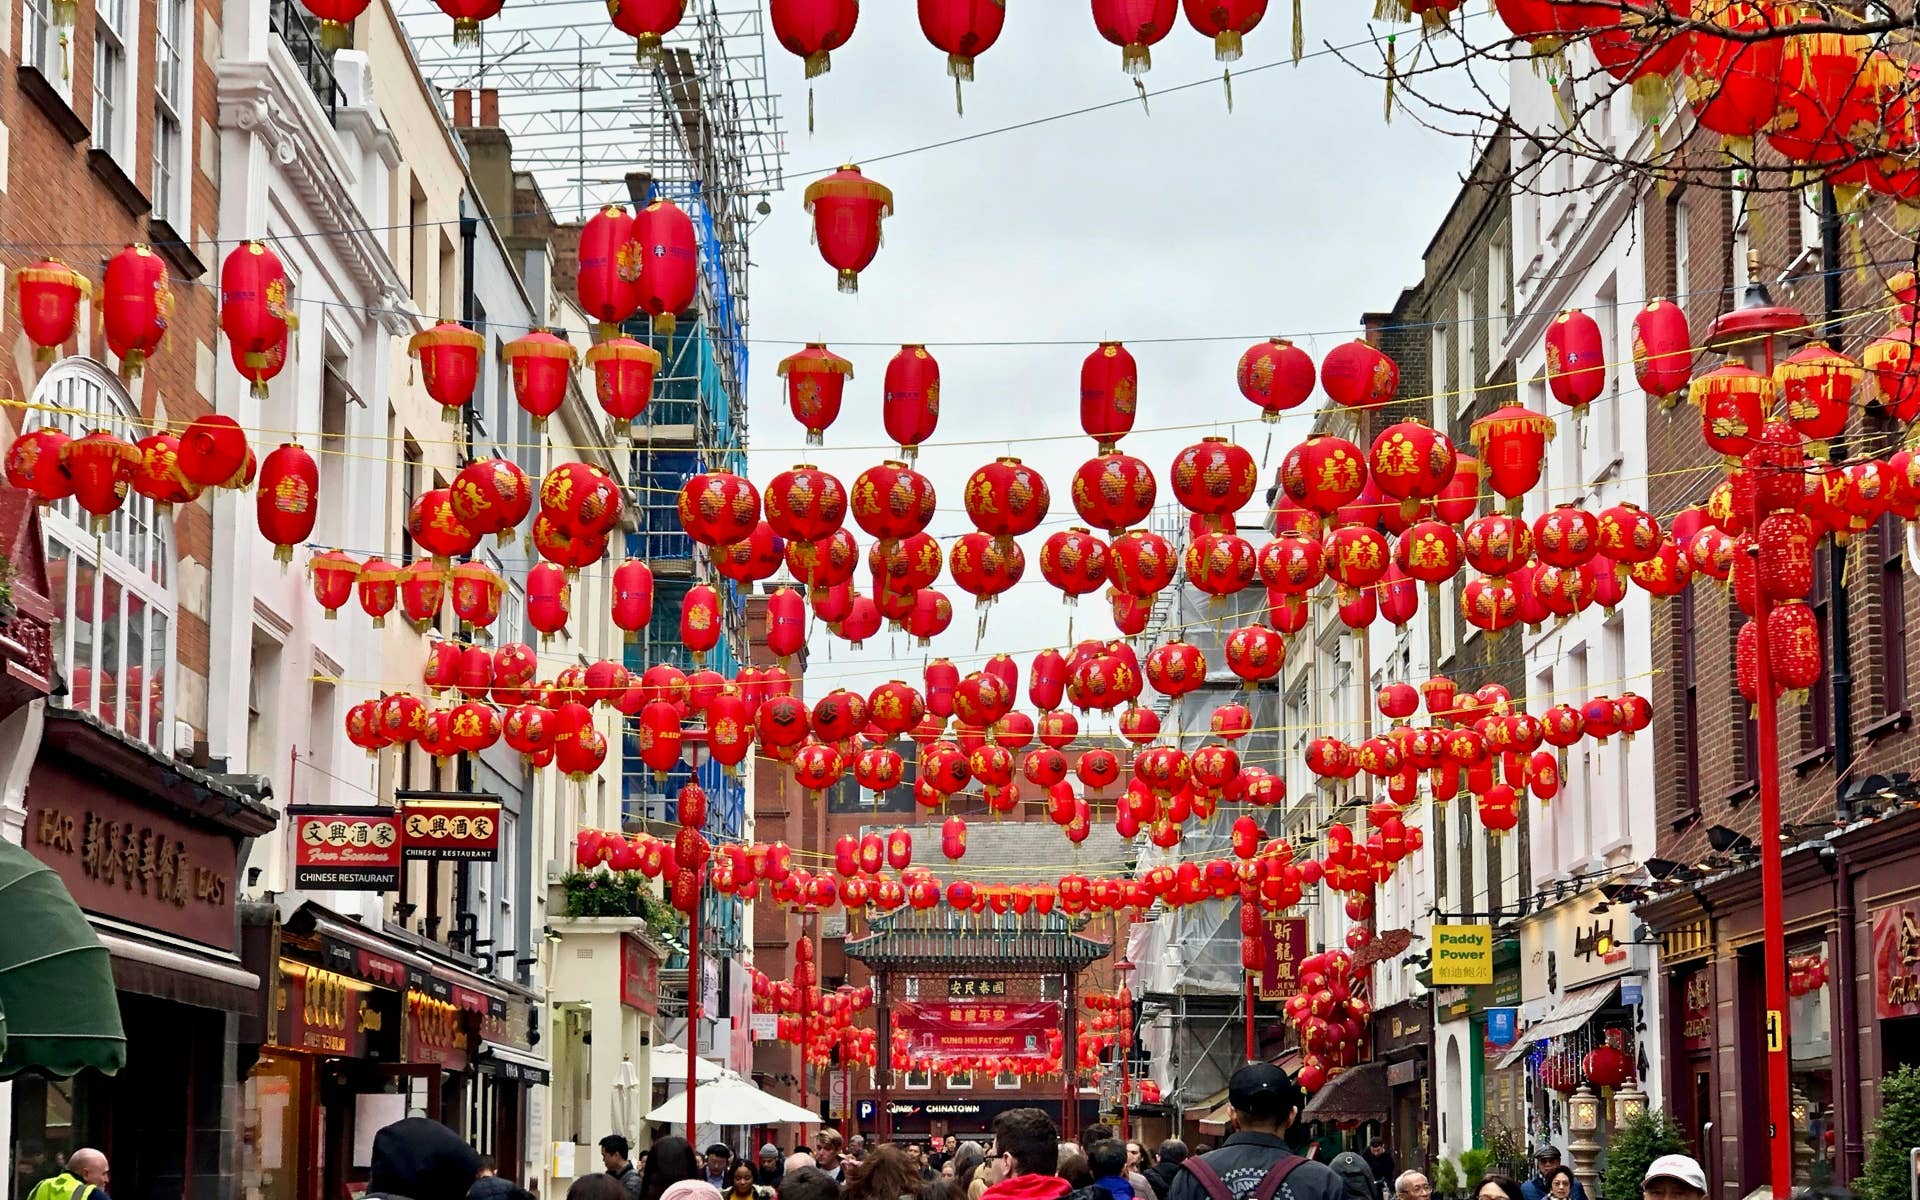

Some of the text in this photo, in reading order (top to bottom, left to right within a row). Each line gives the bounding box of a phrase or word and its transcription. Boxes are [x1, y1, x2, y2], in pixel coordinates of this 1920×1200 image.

[409, 815, 489, 838] 文興酒家
[305, 822, 393, 844] 文興酒家
[308, 848, 390, 863] Four Seasons
[406, 849, 492, 858] CHINESE RESTAURANT
[300, 873, 394, 883] CHINESE RESTAURANT
[1440, 934, 1484, 946] Paddy
[1440, 950, 1485, 960] Power
[1264, 989, 1285, 997] LOON
[941, 1036, 1014, 1044] KUNG HEI FAT CHOY
[862, 1103, 872, 1118] P
[926, 1104, 980, 1113] CHINATOWN
